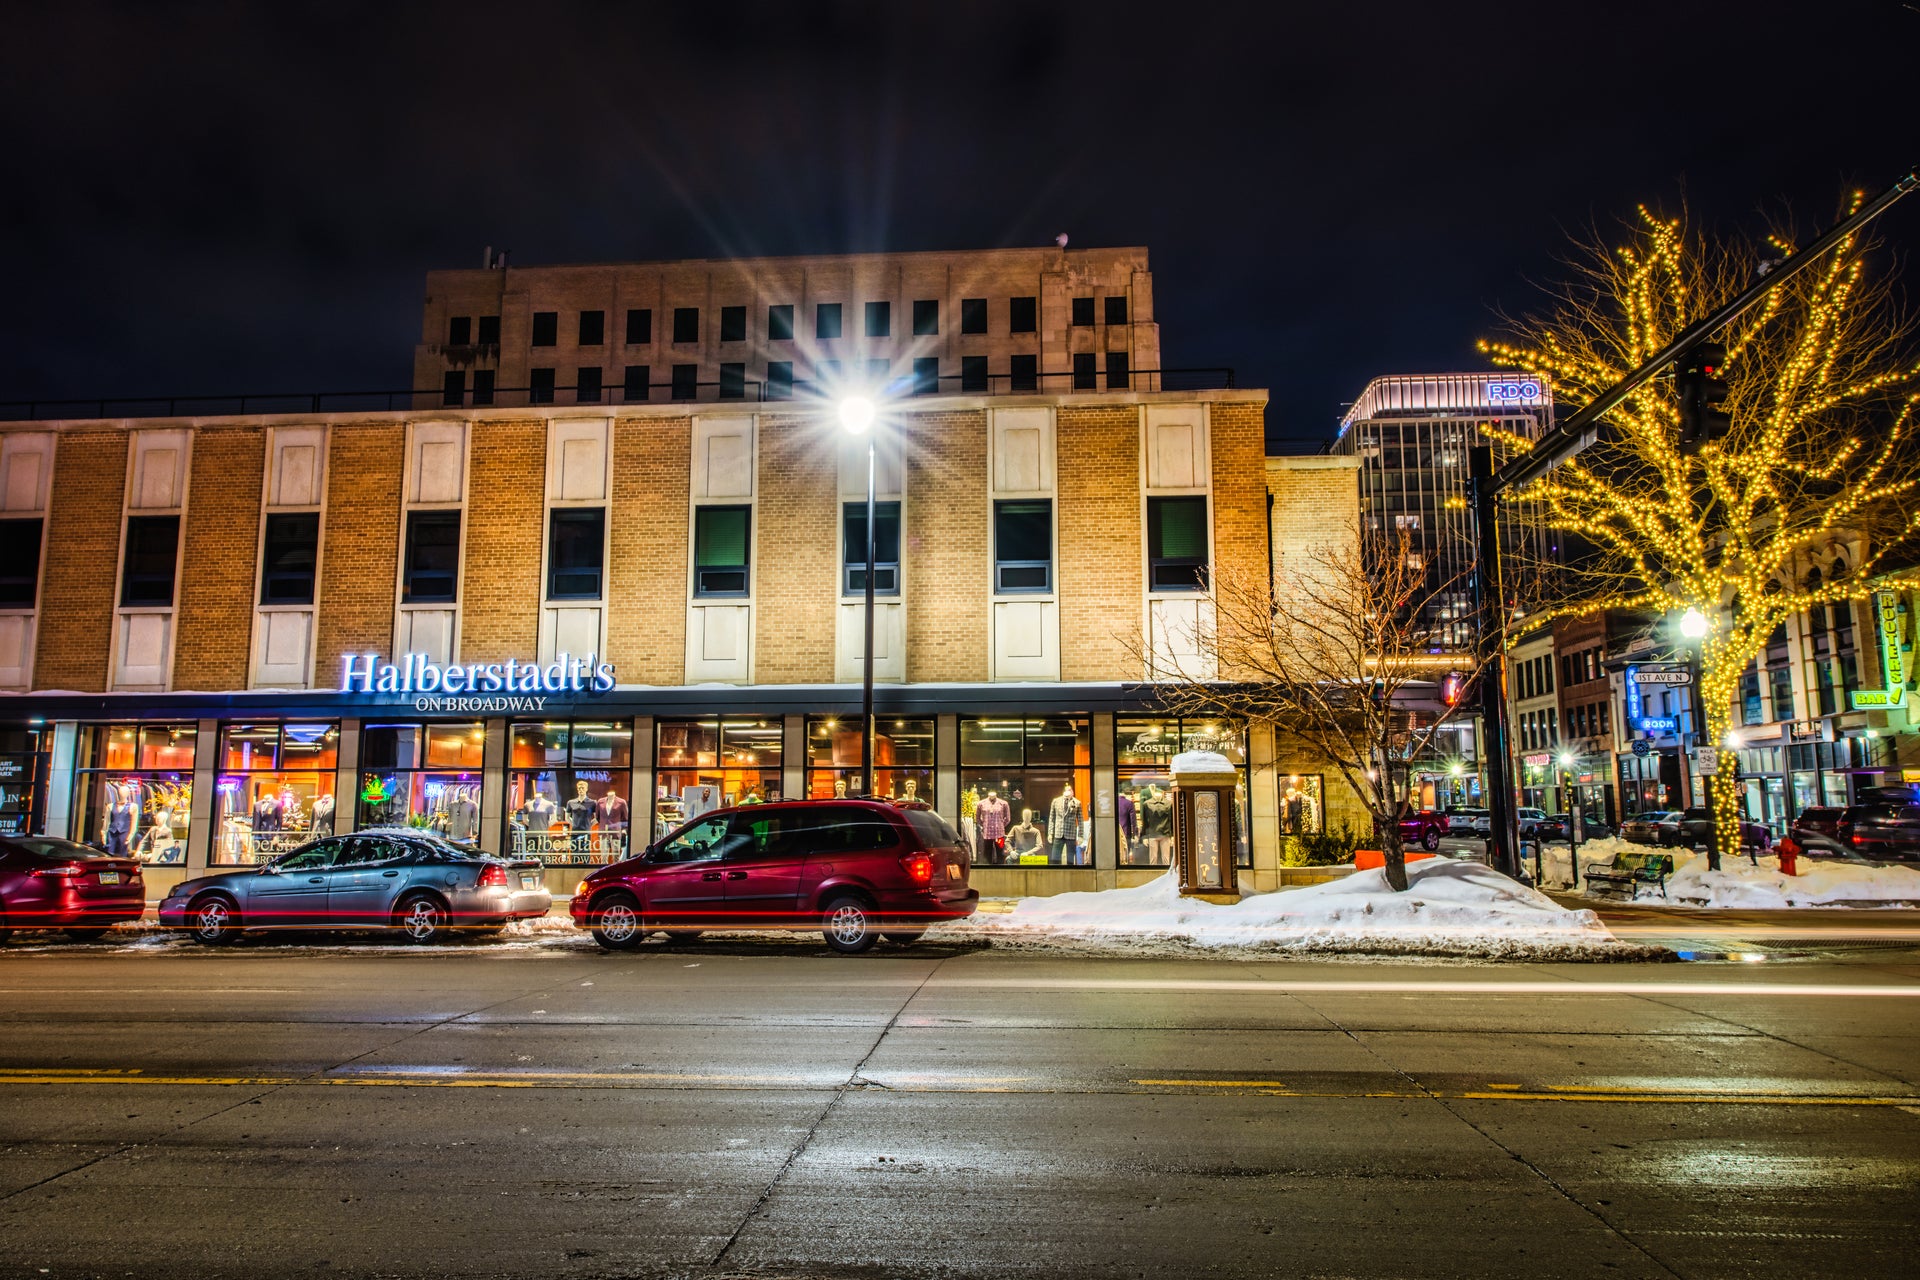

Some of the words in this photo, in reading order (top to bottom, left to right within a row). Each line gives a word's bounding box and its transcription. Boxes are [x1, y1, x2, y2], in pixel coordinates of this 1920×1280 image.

[1487, 382, 1540, 400] RDO
[1882, 595, 1902, 684] ROOTERS
[341, 653, 616, 692] Halberstadt's
[415, 697, 445, 711] ON
[446, 697, 547, 711] BROADWAY
[1855, 693, 1887, 705] BAR
[1645, 720, 1675, 728] ROOM
[1126, 744, 1171, 753] LACOSTE
